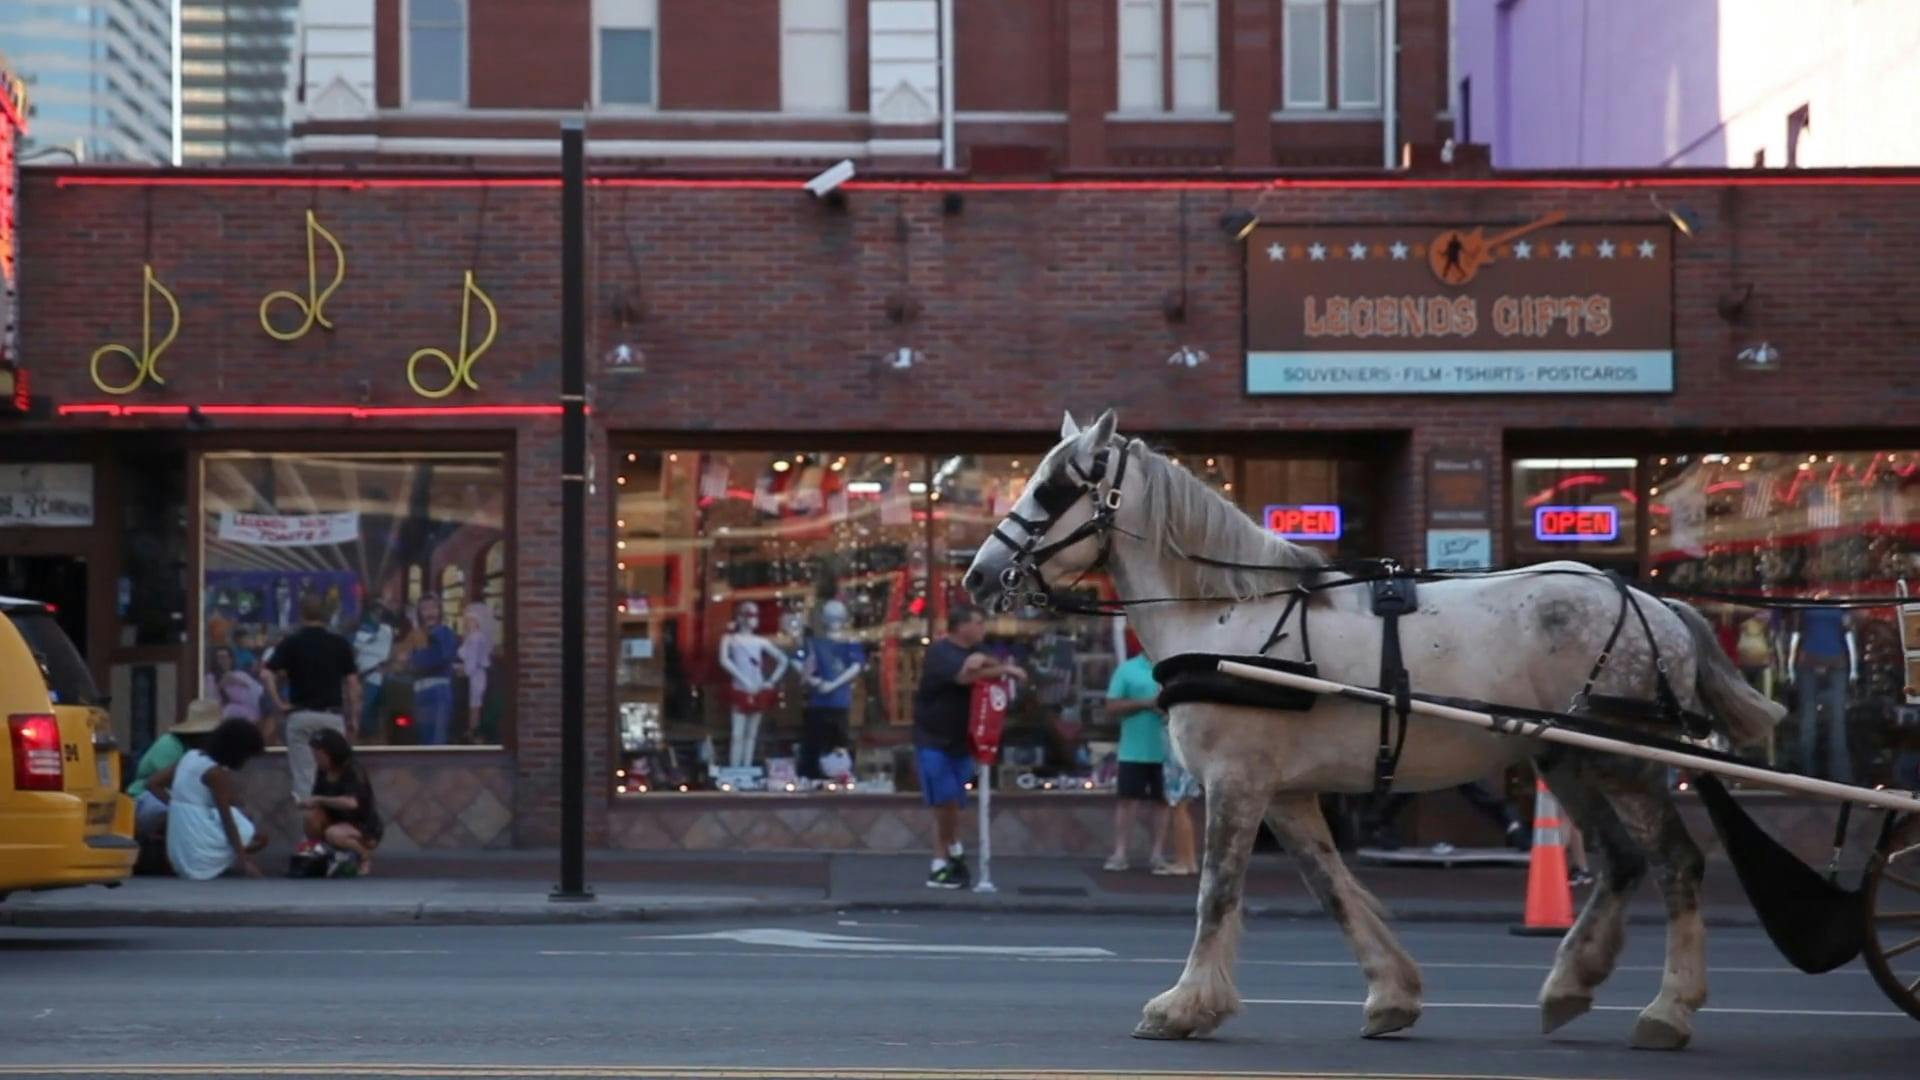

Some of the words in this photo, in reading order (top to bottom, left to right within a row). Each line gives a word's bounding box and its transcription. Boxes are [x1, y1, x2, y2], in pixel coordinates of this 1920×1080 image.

[1303, 294, 1478, 338] LEGENDS
[1492, 294, 1613, 337] GIFTS
[1282, 366, 1392, 383] SOUVENIERS
[1402, 366, 1442, 382] FILM
[1454, 366, 1526, 382] TSHIRTS
[1536, 365, 1638, 382] POSTCARDS
[1270, 509, 1335, 533] OPEN
[1542, 511, 1609, 534] OPEN
